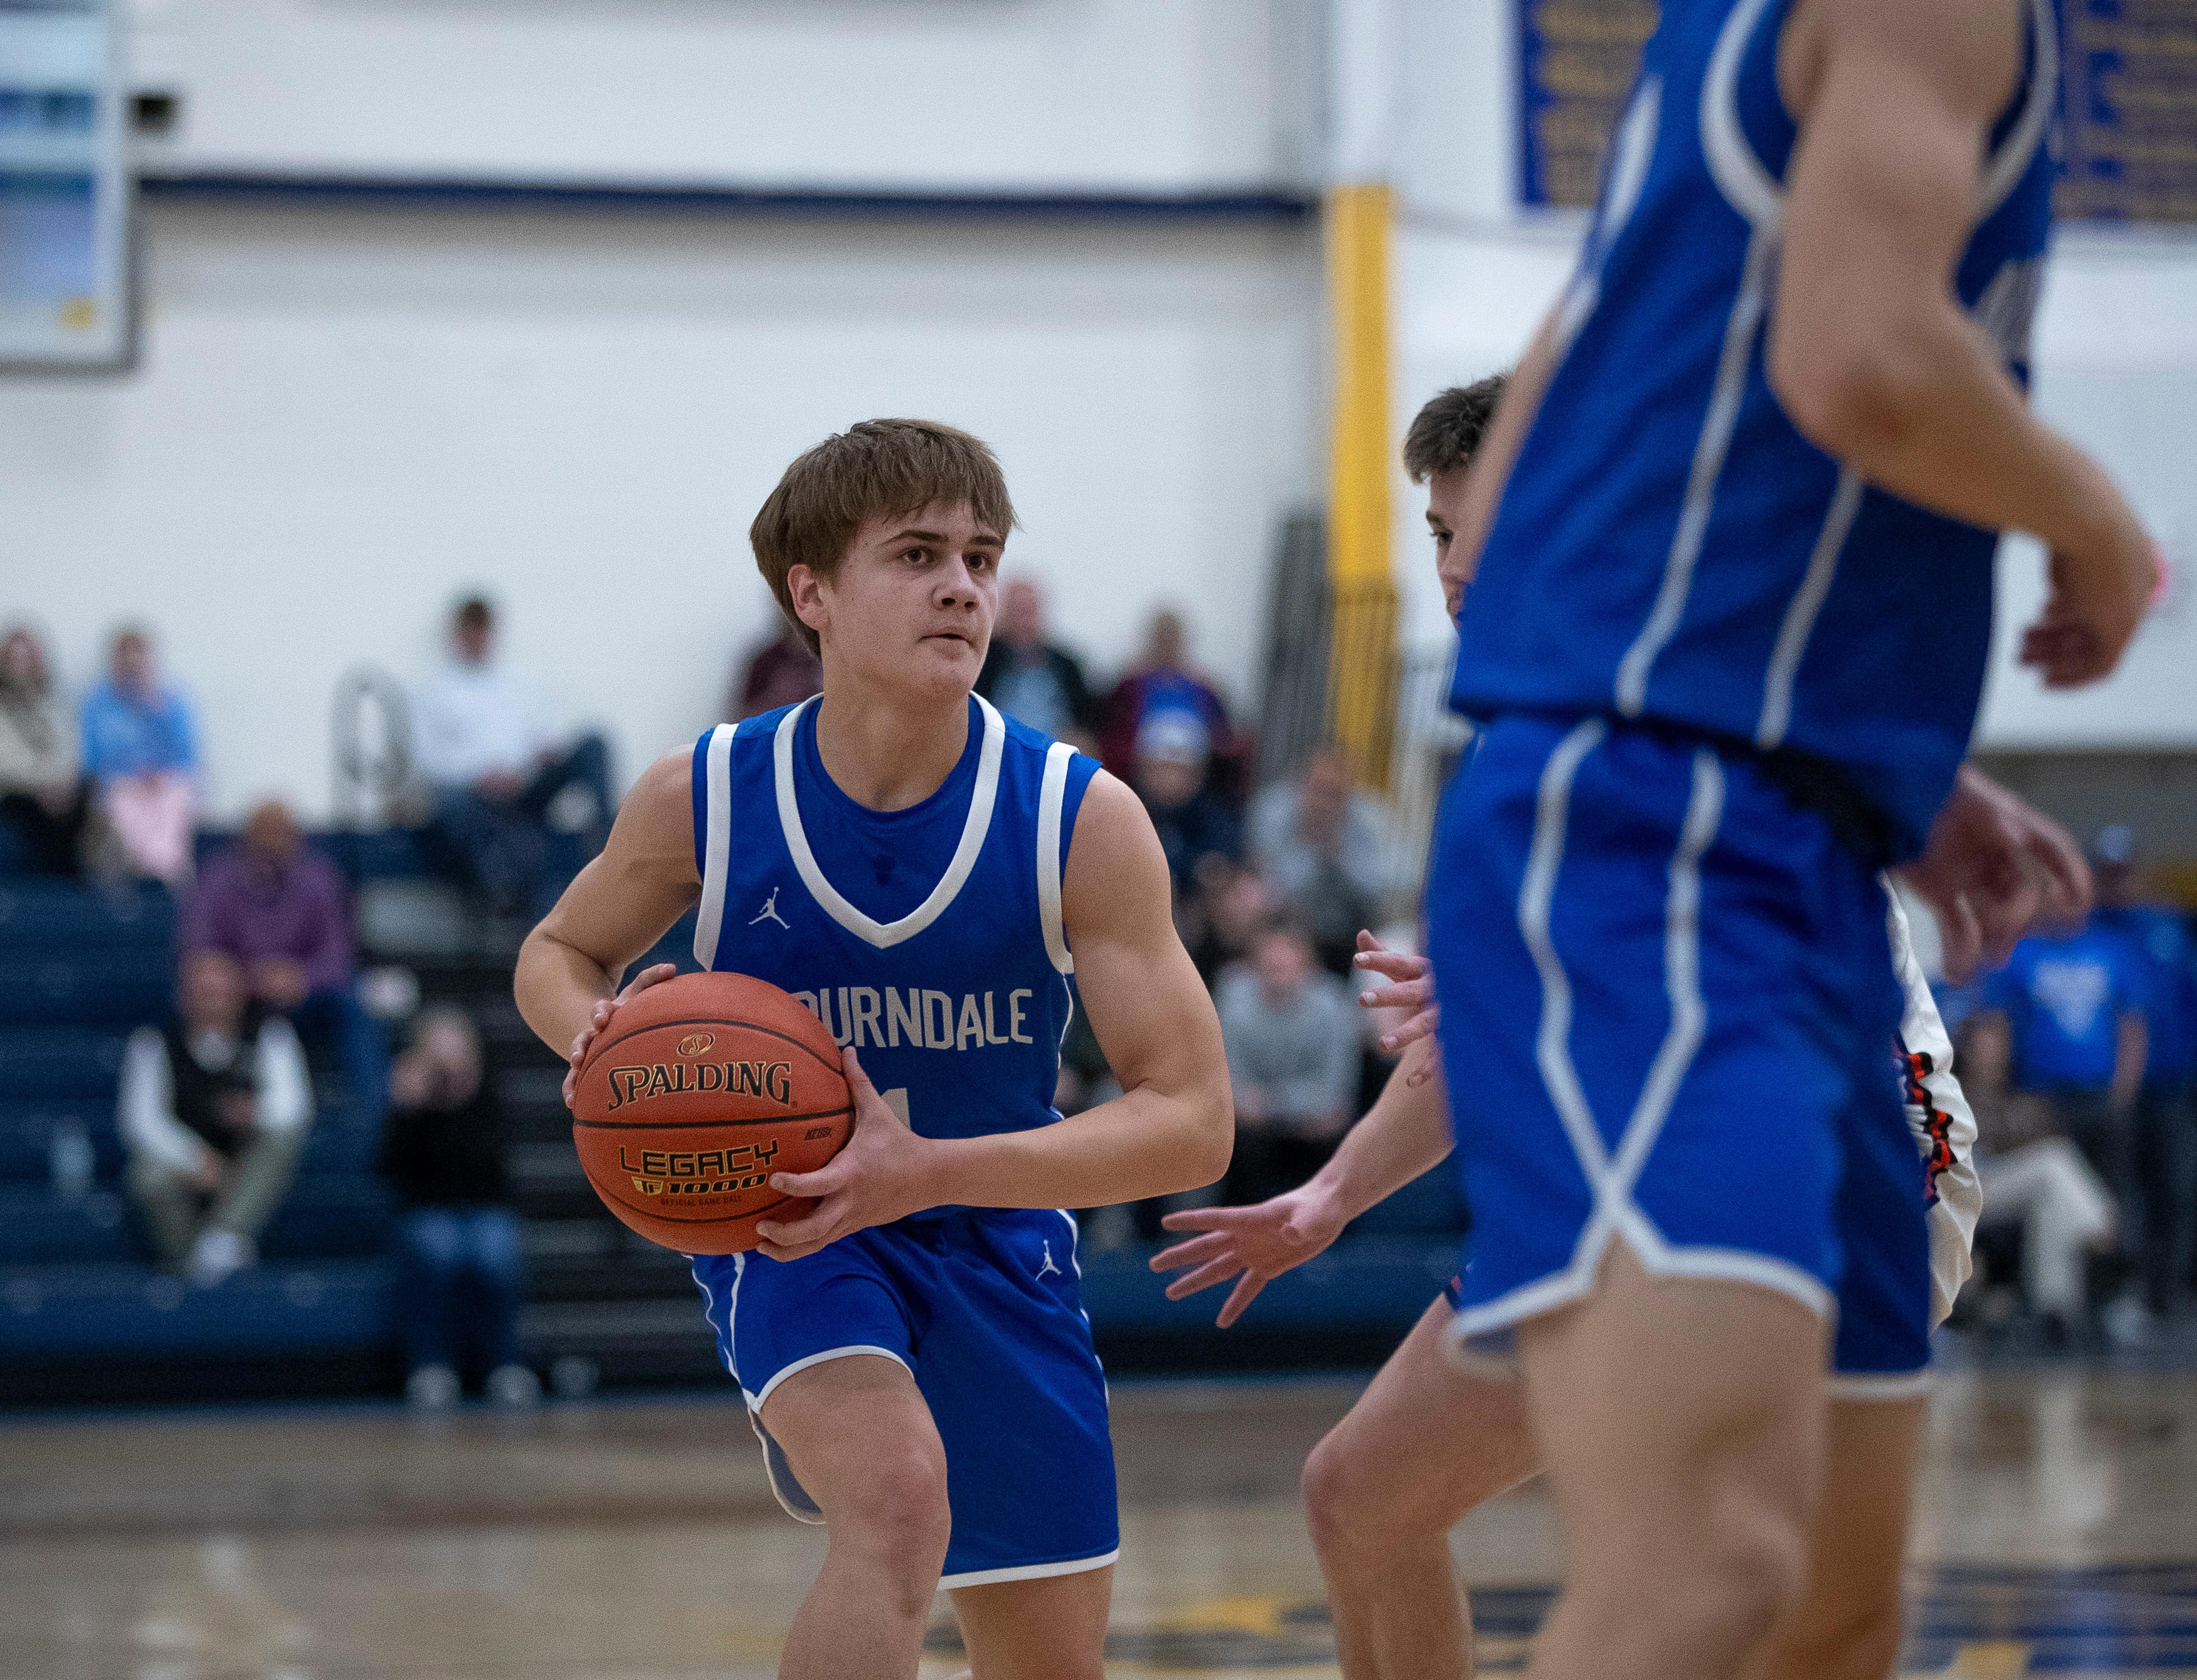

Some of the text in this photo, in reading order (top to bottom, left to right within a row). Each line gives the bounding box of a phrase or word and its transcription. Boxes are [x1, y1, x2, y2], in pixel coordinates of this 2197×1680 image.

[608, 1061, 792, 1111] SPALDING
[620, 1138, 778, 1177] LEGACY
[699, 1197, 720, 1205] GAME
